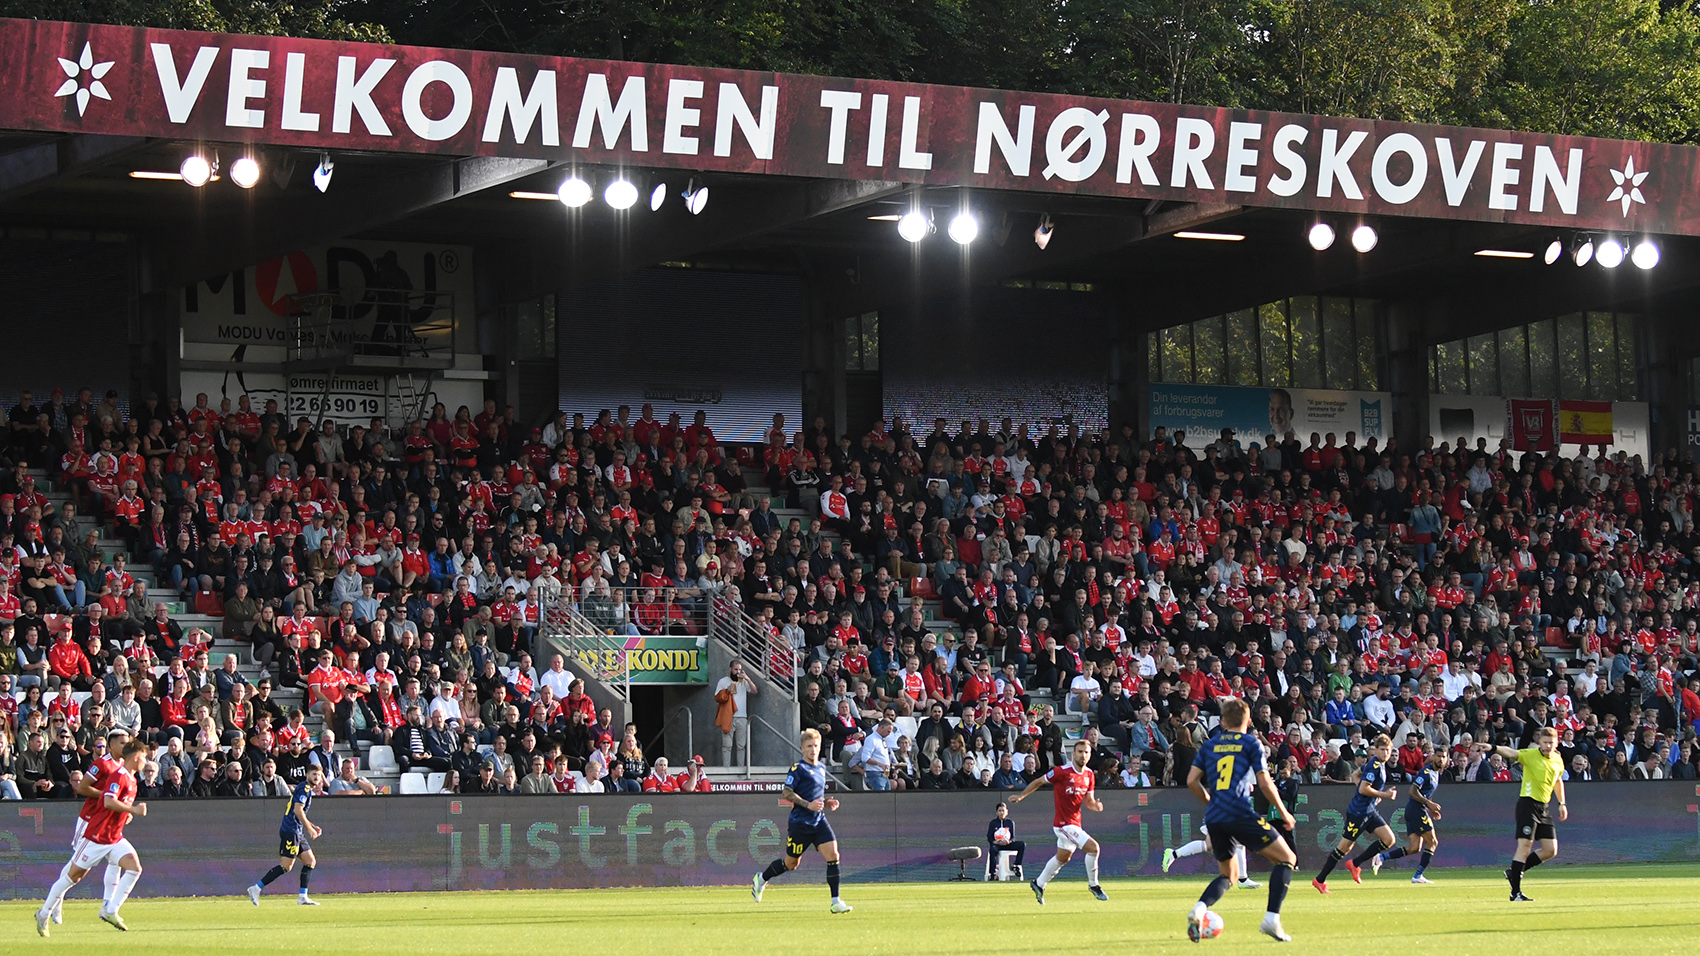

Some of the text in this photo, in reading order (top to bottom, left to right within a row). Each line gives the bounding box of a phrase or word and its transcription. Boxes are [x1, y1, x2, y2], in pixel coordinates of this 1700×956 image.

[150, 42, 1583, 215] VELKOMMEN TIL NØRRESKOVEN
[218, 325, 262, 340] MODU
[266, 327, 315, 342] Vaves
[290, 375, 379, 392] ømrefirmaet
[1152, 391, 1168, 403] Din
[334, 398, 356, 413] 90
[359, 399, 379, 414] 19
[1153, 405, 1225, 419] af forbrugsvarer
[1363, 408, 1379, 417] B2B
[1364, 417, 1379, 427] SUP
[1364, 427, 1379, 437] PLY
[628, 649, 699, 671] KONDI
[1216, 754, 1235, 791] 3
[754, 783, 764, 791] TIL
[434, 801, 782, 887] justface
[791, 842, 804, 855] 10
